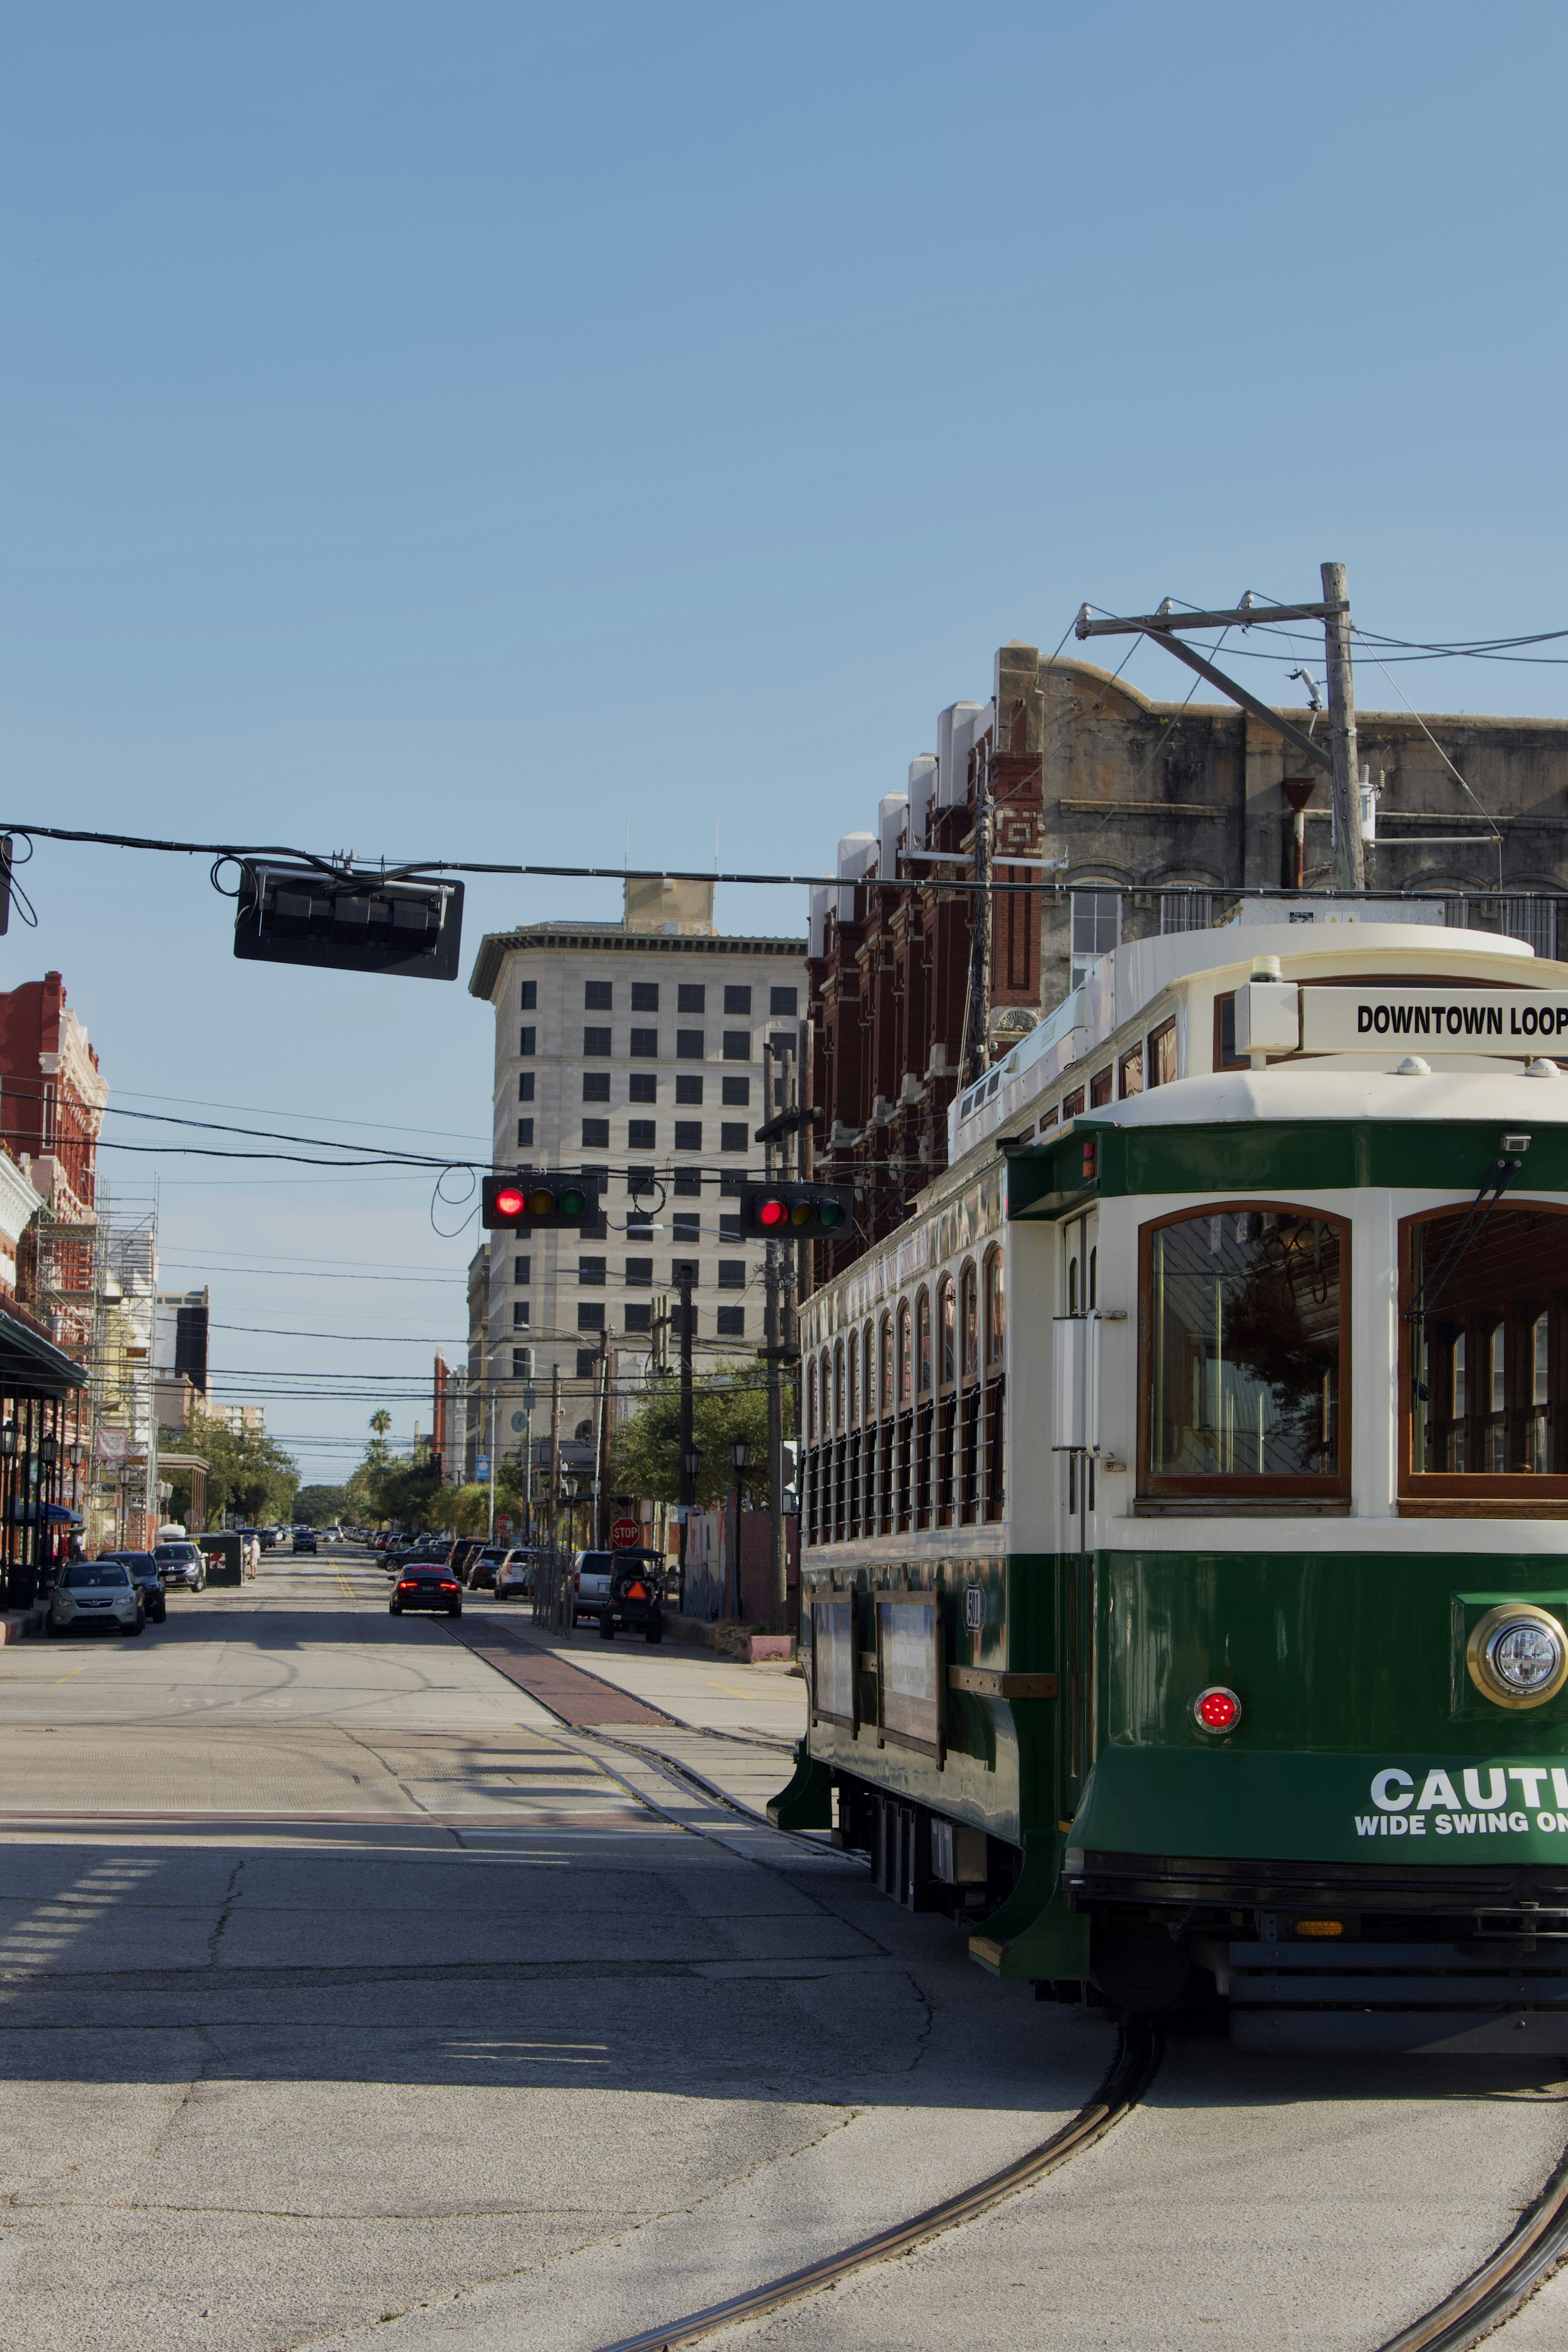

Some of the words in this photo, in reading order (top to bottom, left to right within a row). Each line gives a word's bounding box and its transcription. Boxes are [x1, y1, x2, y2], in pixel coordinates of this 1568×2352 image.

[1357, 1005, 1503, 1035] DOWNTOWN
[1511, 1007, 1568, 1035] LOOP
[876, 1256, 896, 1292] ISLAND
[614, 1527, 637, 1538] STOP
[968, 1592, 979, 1625] 501
[1370, 1768, 1568, 1812] CAUTI
[1355, 1815, 1427, 1836] WIDE
[1435, 1812, 1530, 1835] SWING
[1537, 1812, 1568, 1833] ON
